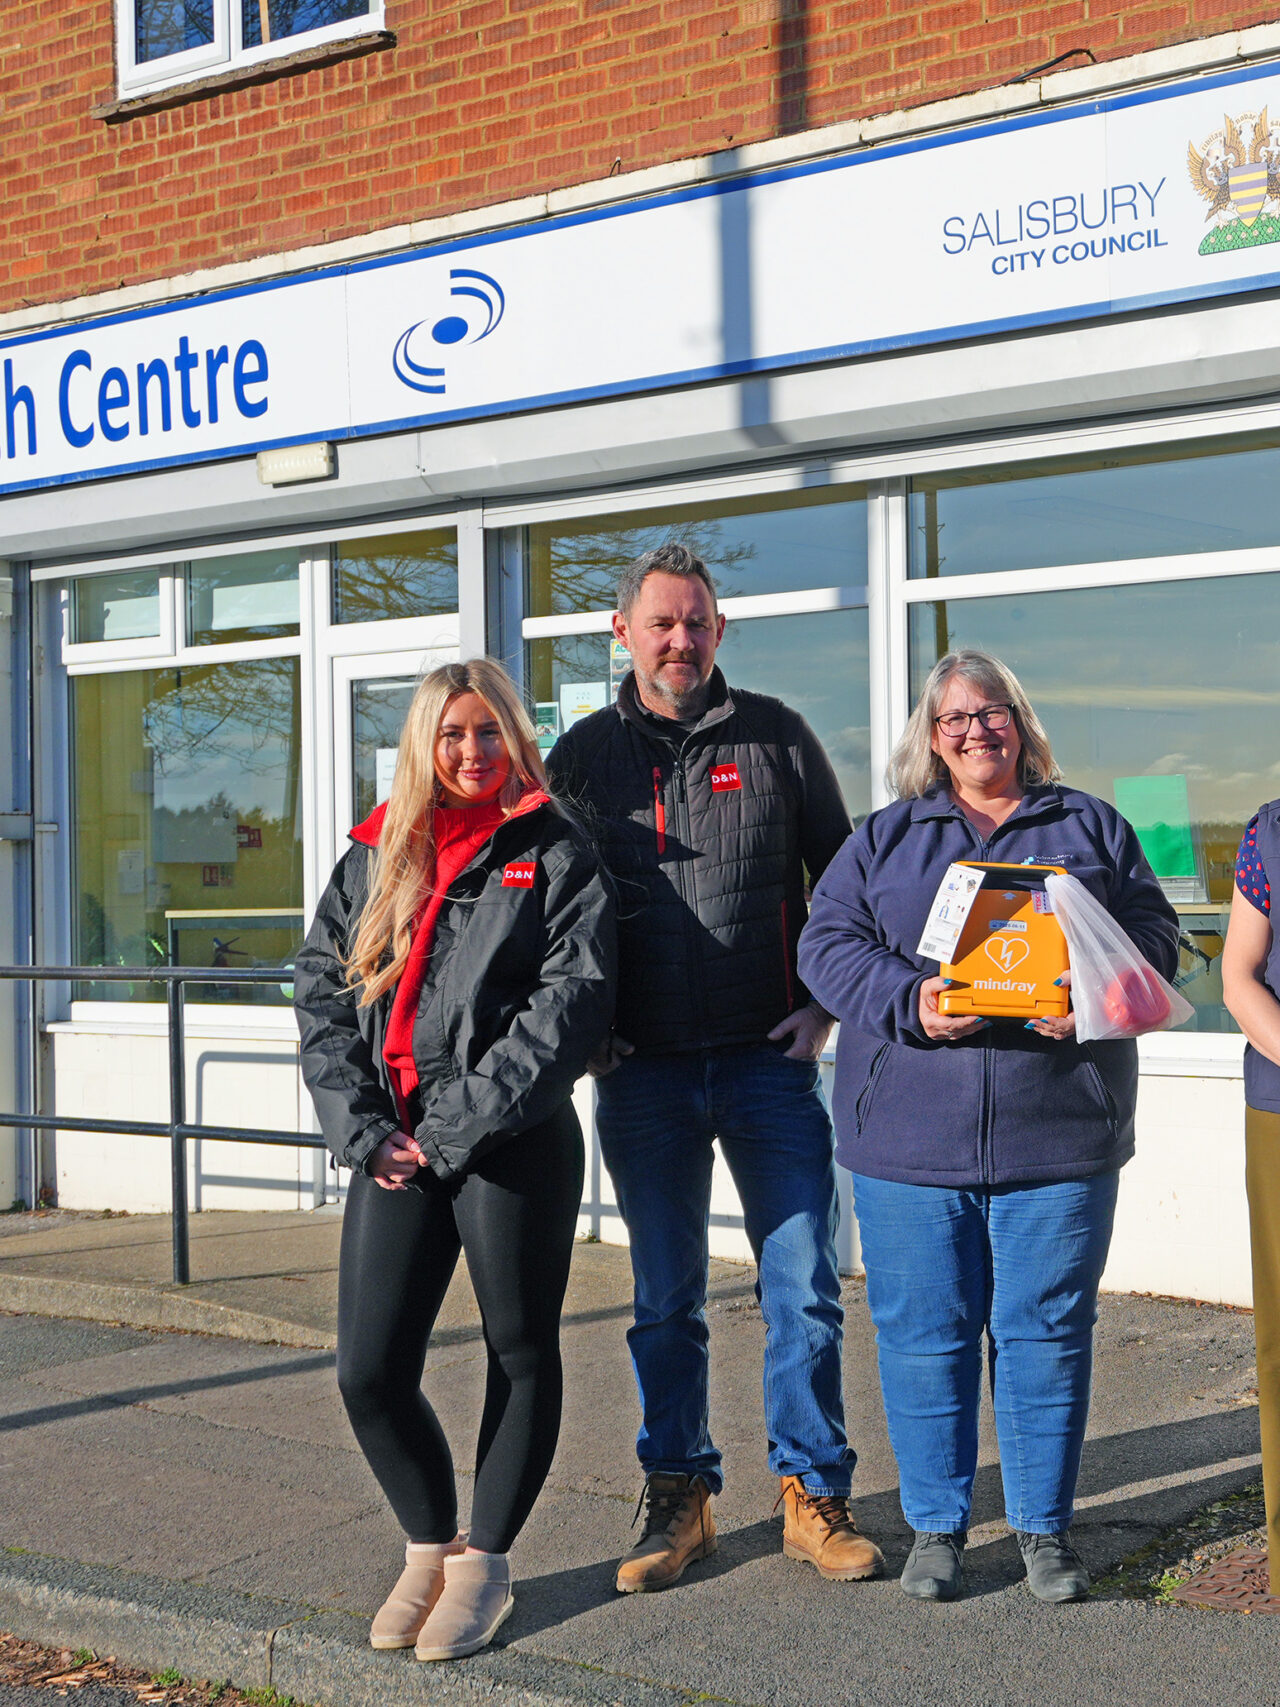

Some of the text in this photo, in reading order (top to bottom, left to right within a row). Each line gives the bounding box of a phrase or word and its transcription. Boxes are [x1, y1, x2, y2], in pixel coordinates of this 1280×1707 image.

[943, 177, 1166, 254] SALISBURY
[992, 228, 1168, 275] CITY COUNCIL
[59, 335, 269, 448] Centre
[711, 772, 737, 784] D&N
[505, 870, 534, 880] D&N
[973, 978, 1037, 995] mindray
